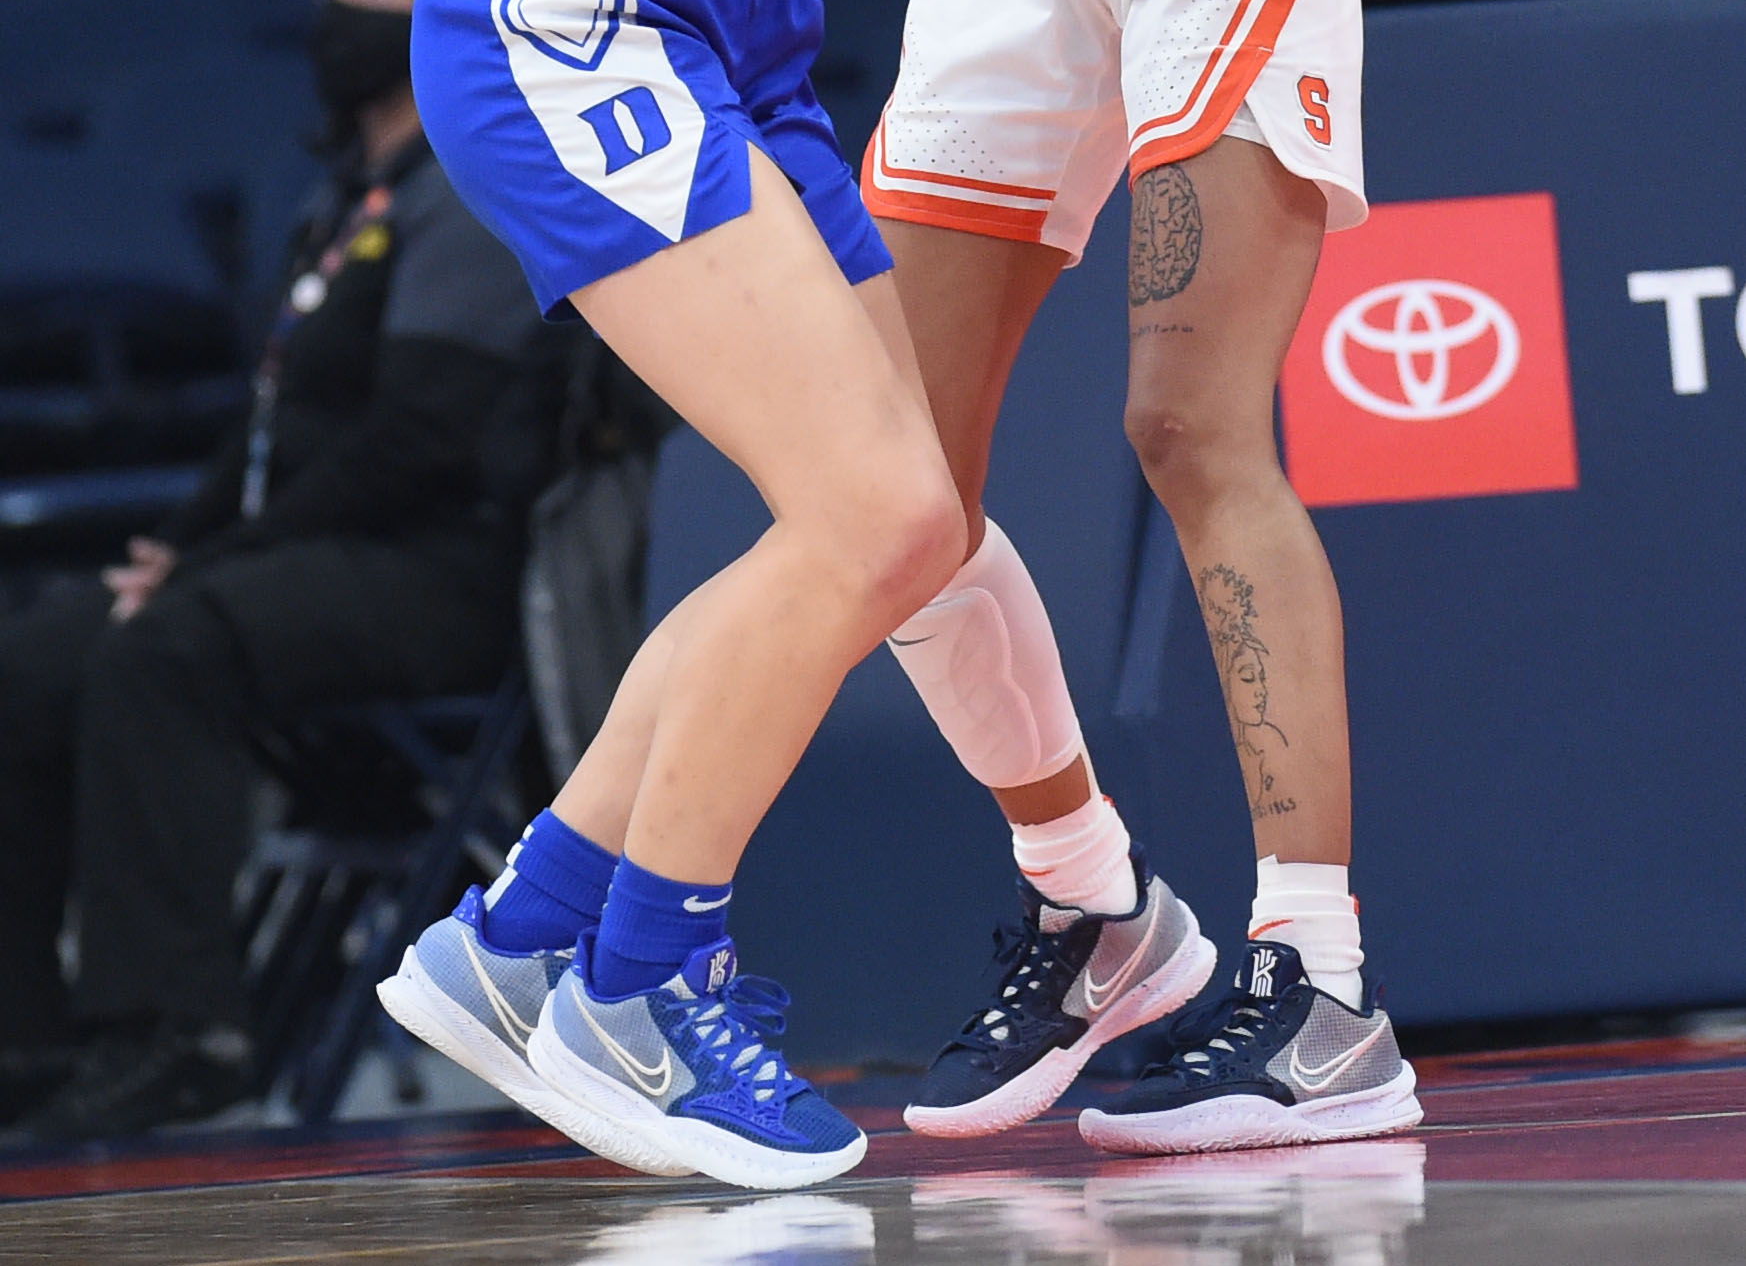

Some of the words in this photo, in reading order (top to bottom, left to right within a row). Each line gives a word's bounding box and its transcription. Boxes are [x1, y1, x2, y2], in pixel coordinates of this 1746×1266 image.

[577, 85, 672, 176] D
[1296, 73, 1331, 147] S
[1626, 265, 1746, 395] T
